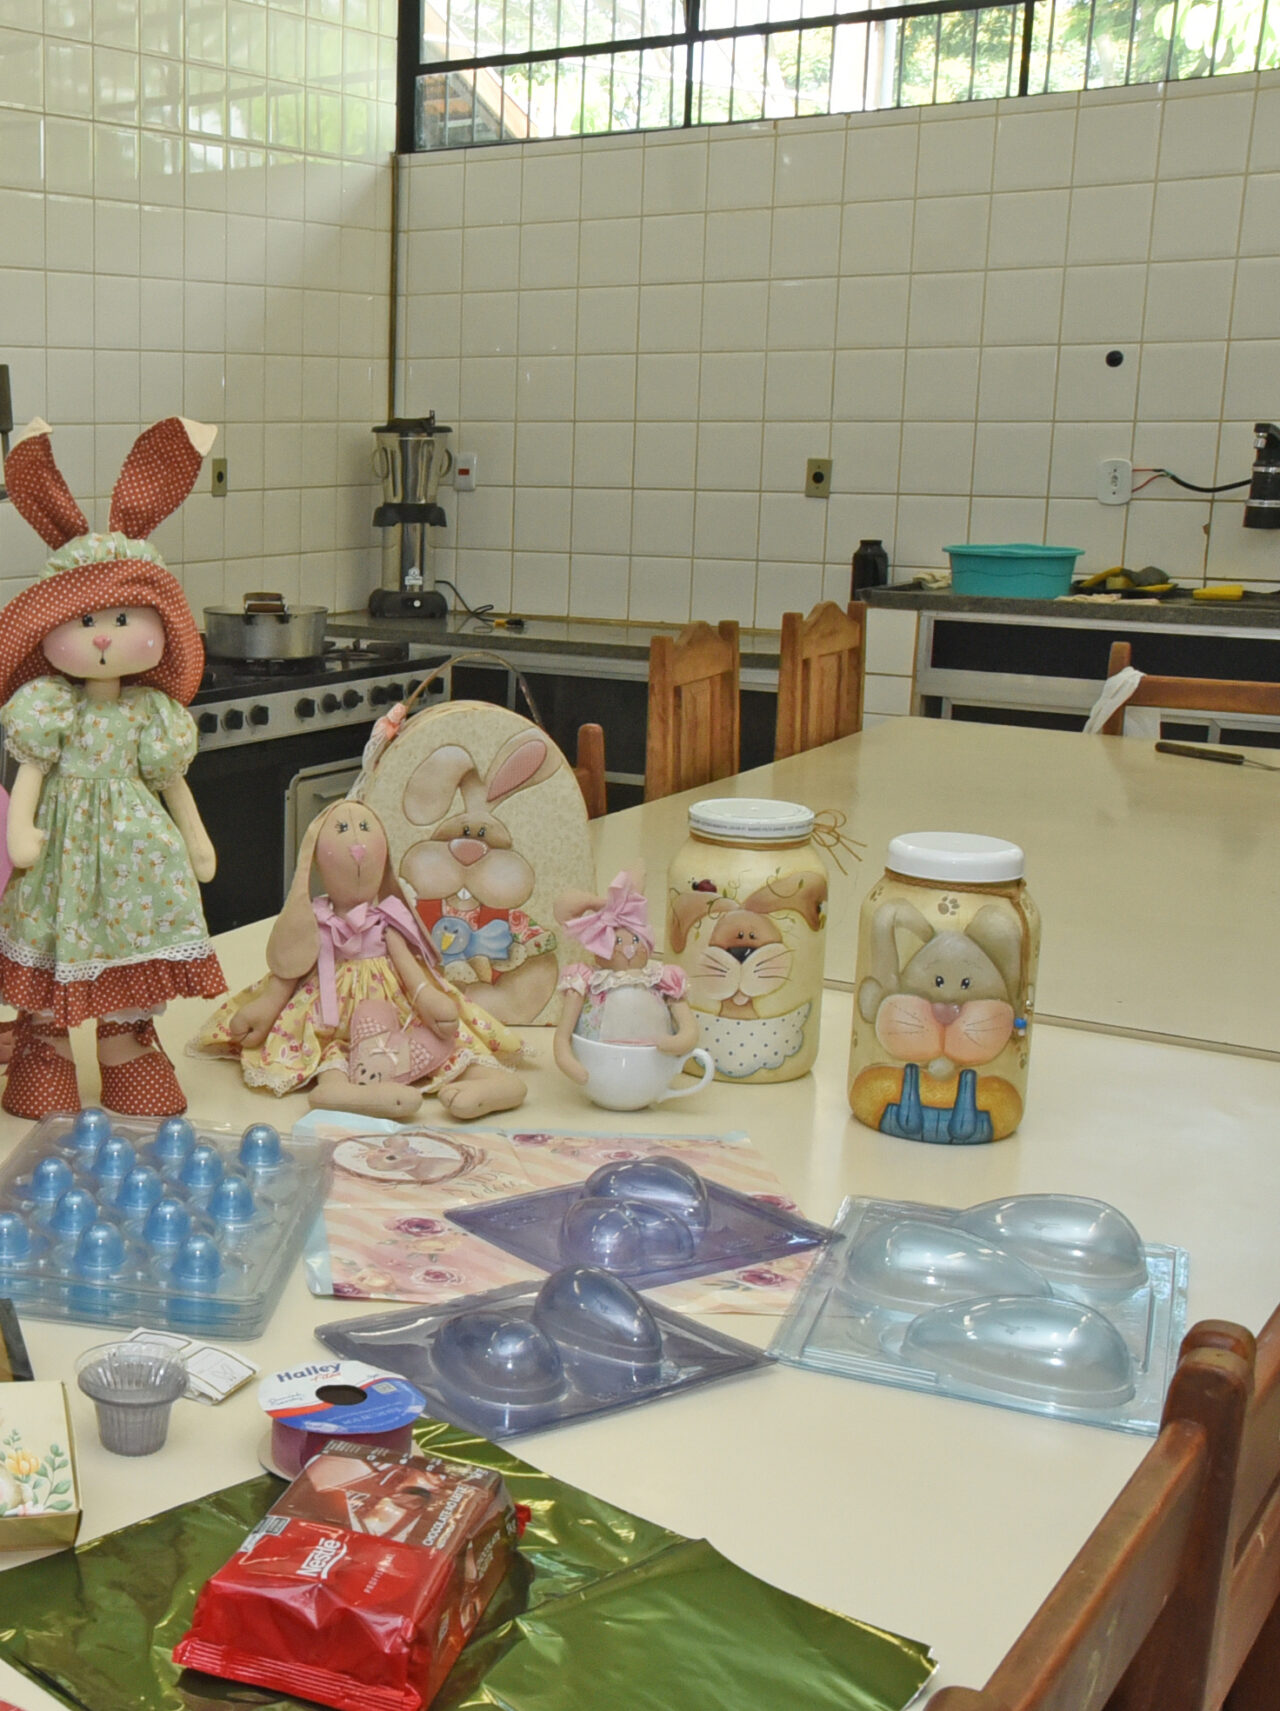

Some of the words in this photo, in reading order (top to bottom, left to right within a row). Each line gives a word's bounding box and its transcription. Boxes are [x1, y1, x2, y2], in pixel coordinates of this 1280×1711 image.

[276, 1362, 342, 1383] Halley
[450, 1483, 468, 1503] LEITE
[443, 1498, 458, 1513] AO
[422, 1507, 453, 1547] CHOCOLATE
[296, 1537, 342, 1577] Nestlé
